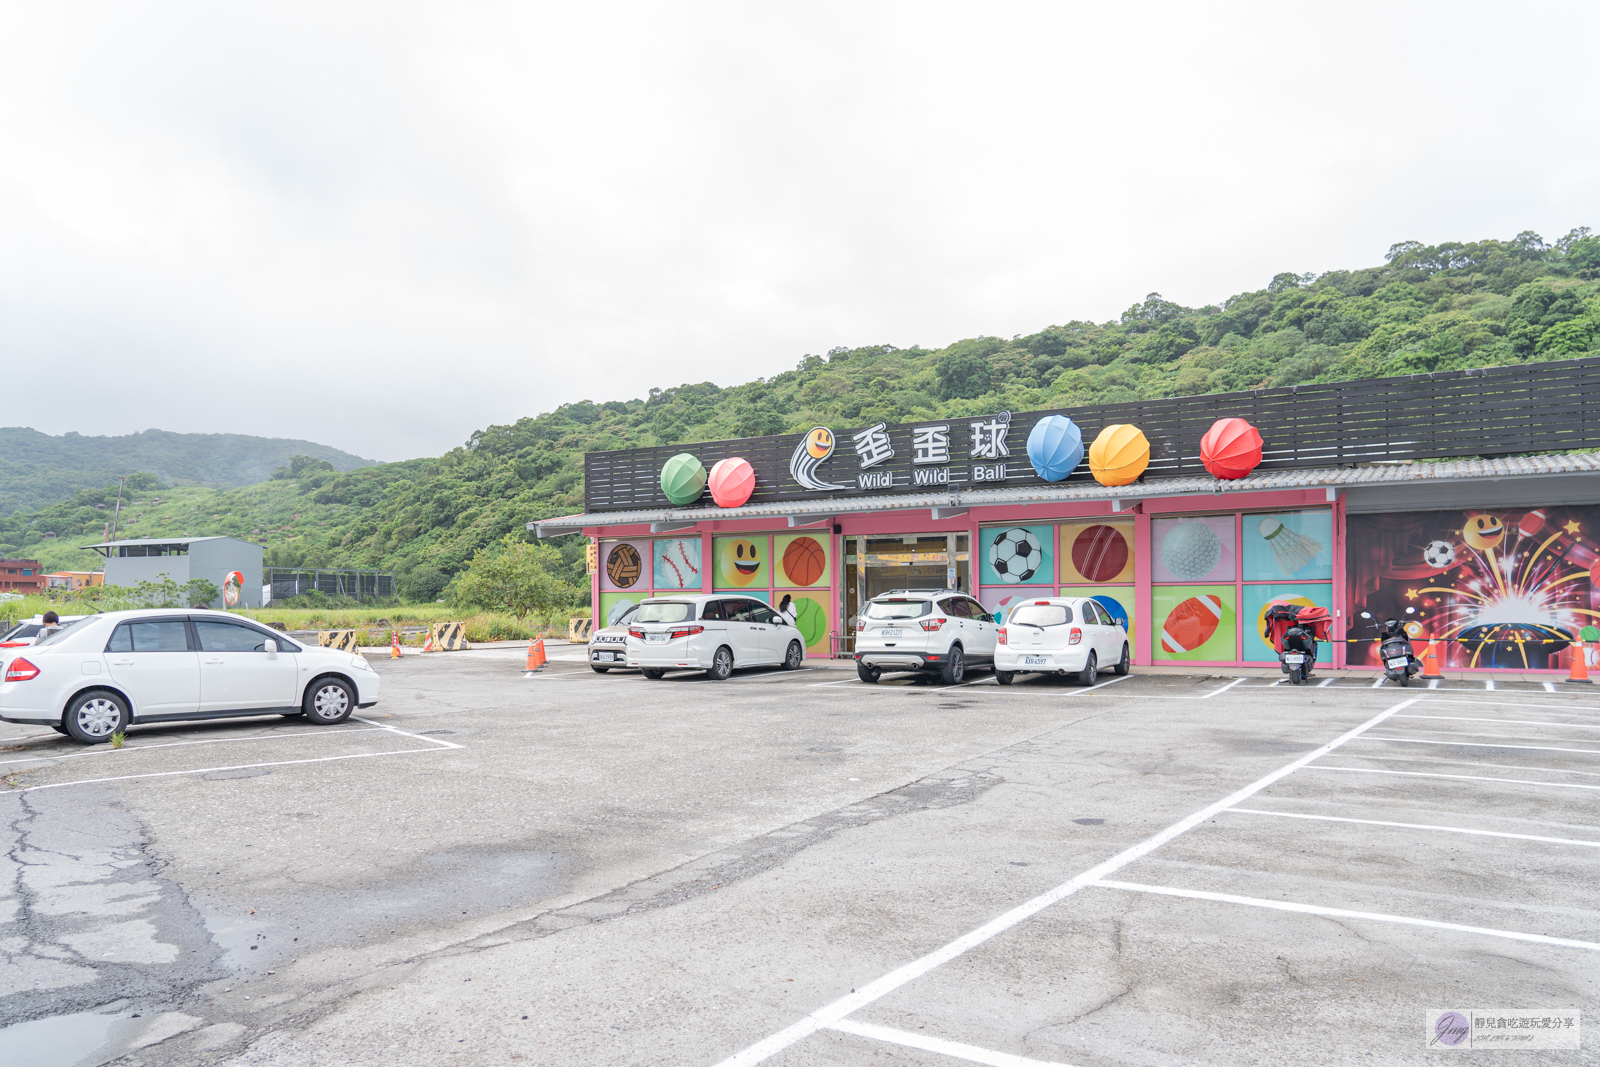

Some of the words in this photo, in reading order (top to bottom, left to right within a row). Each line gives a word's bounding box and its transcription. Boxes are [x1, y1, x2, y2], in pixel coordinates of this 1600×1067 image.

[853, 411, 1010, 470] 歪歪球
[858, 471, 892, 490] Wild
[914, 467, 949, 486] Wild
[973, 463, 1006, 482] Ball
